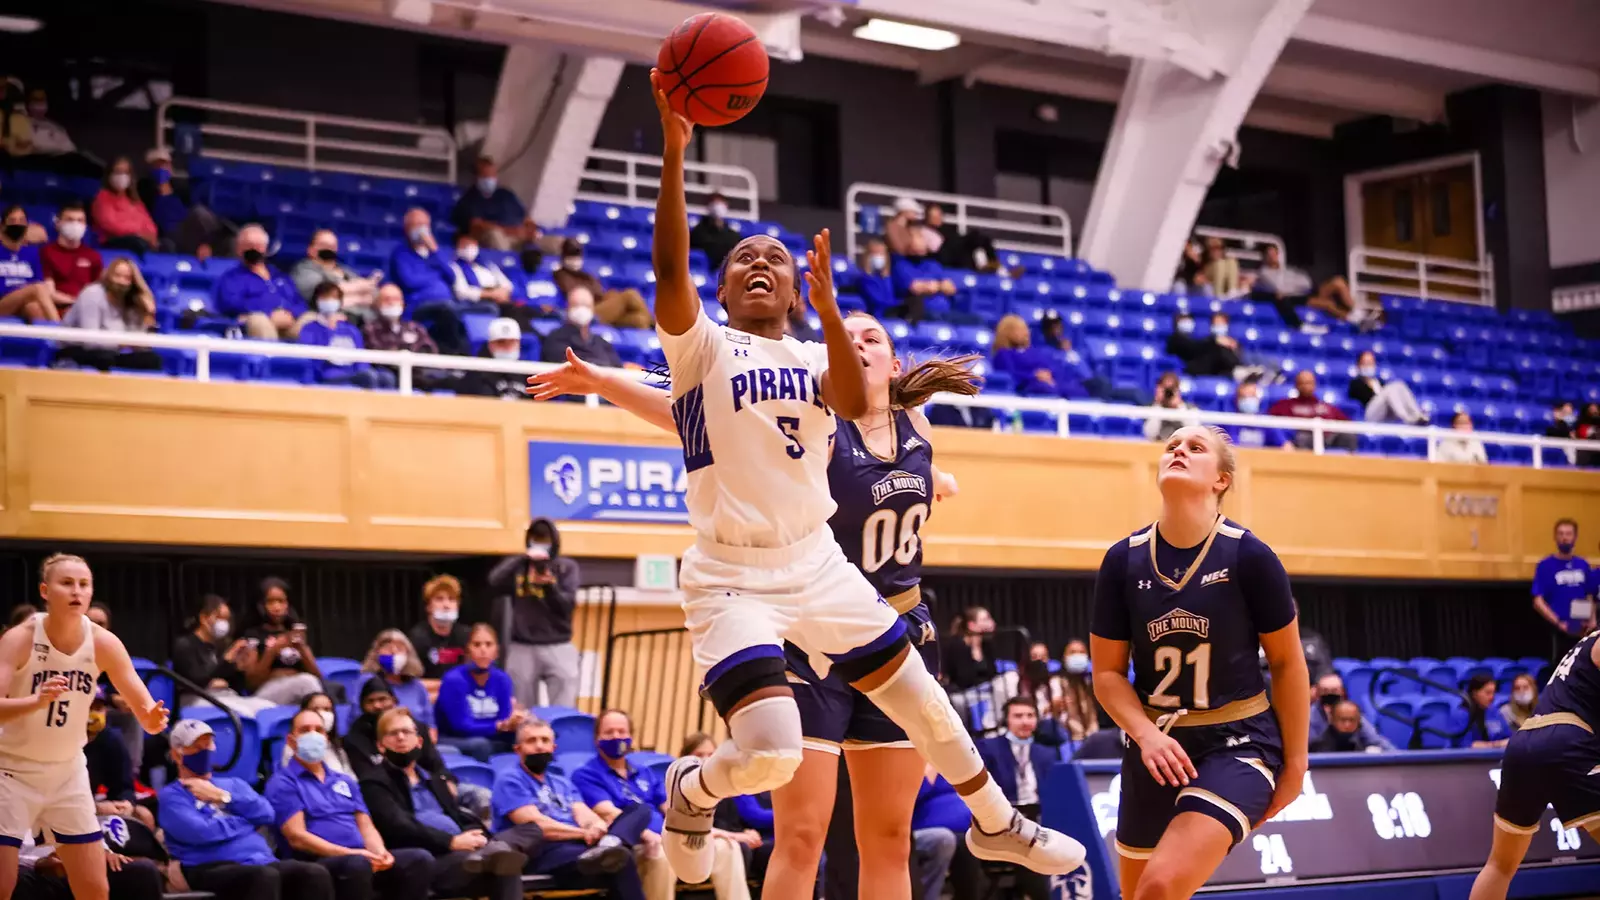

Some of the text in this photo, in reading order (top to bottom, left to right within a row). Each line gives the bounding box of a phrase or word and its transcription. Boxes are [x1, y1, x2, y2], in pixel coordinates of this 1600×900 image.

[730, 368, 831, 412] PIRAT
[776, 416, 805, 459] 5
[588, 492, 687, 508] BASKE
[873, 477, 926, 500] THE MOUNT
[1200, 568, 1229, 585] NEC
[1149, 616, 1208, 638] THE MOUNT
[1148, 643, 1211, 709] 21
[46, 700, 70, 727] 15
[1253, 834, 1293, 874] 24
